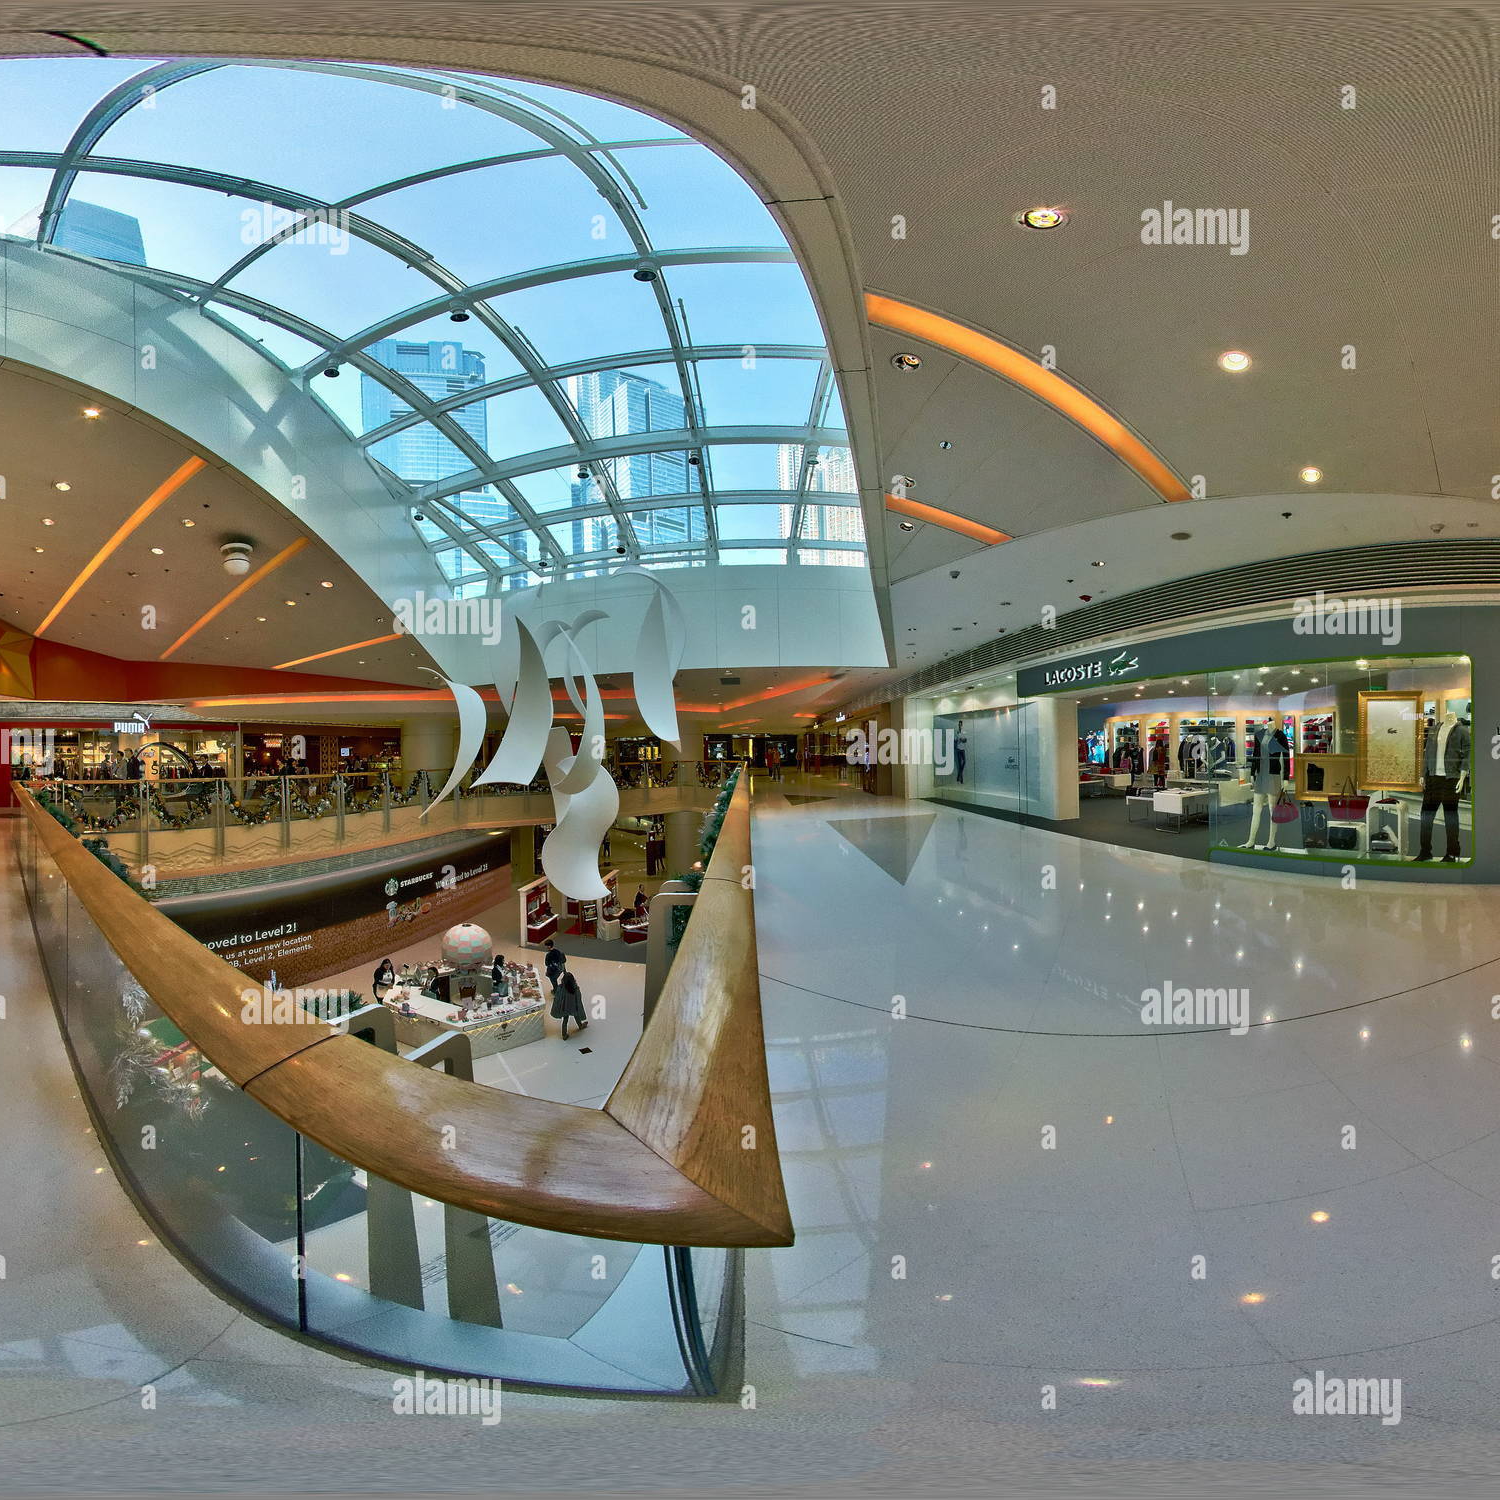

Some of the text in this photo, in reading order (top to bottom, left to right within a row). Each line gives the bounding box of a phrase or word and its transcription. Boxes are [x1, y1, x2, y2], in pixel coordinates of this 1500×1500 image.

[1044, 661, 1102, 686] LACOSTE
[114, 722, 144, 733] PUMA
[400, 872, 434, 888] STARBUCKS
[240, 935, 252, 943] to
[255, 925, 284, 940] Level
[286, 922, 297, 934] 2!
[238, 950, 246, 958] at
[264, 943, 281, 951] new
[282, 934, 312, 947] location
[244, 954, 266, 965] Level
[268, 952, 275, 960] 2,
[277, 944, 313, 956] Elements.
